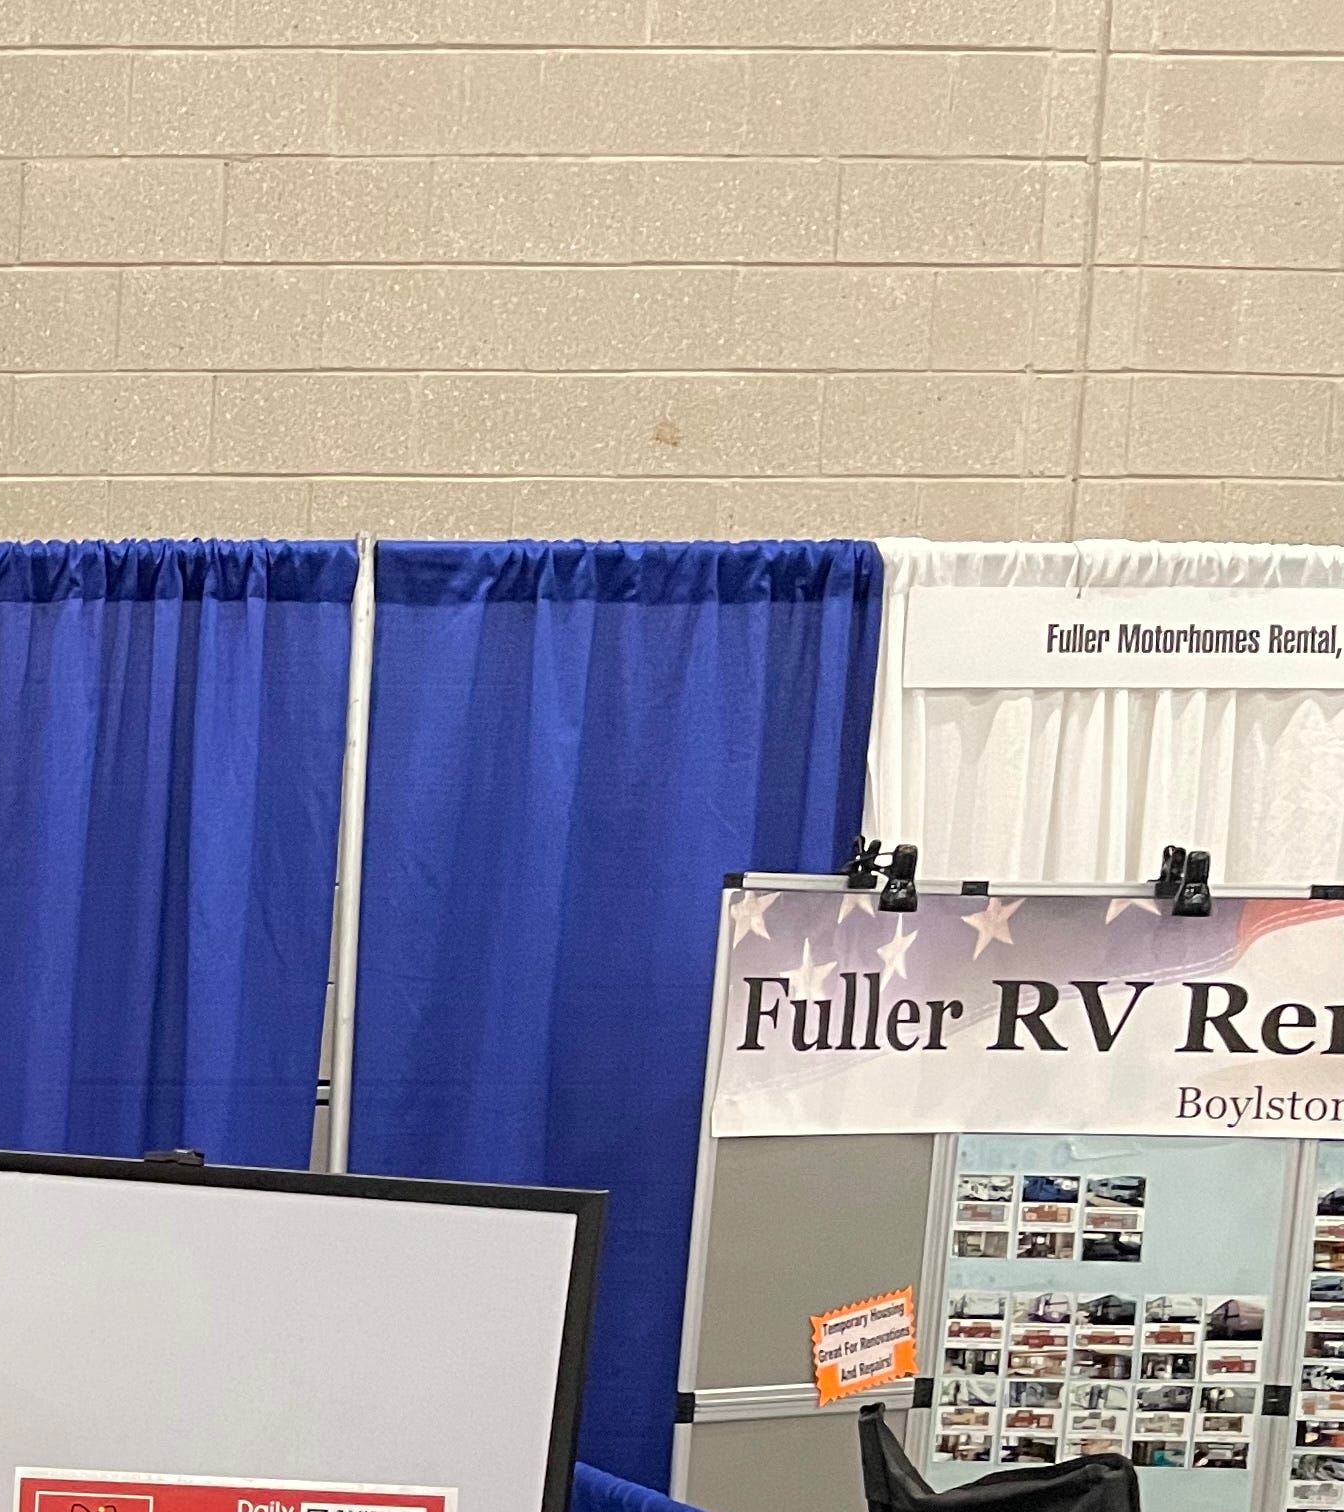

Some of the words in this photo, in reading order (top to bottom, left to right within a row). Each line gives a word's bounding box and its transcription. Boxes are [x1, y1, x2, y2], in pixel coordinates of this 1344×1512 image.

[1047, 624, 1110, 653] Fuller
[1117, 624, 1261, 654] Motorhomes
[1268, 624, 1342, 659] Rental,
[737, 972, 964, 1053] Fuller
[986, 980, 1155, 1053] RV
[823, 1315, 868, 1336] Temporary
[819, 1346, 842, 1363] Great
[844, 1341, 858, 1355] For
[860, 1327, 910, 1350] Renovations
[841, 1366, 857, 1382] And
